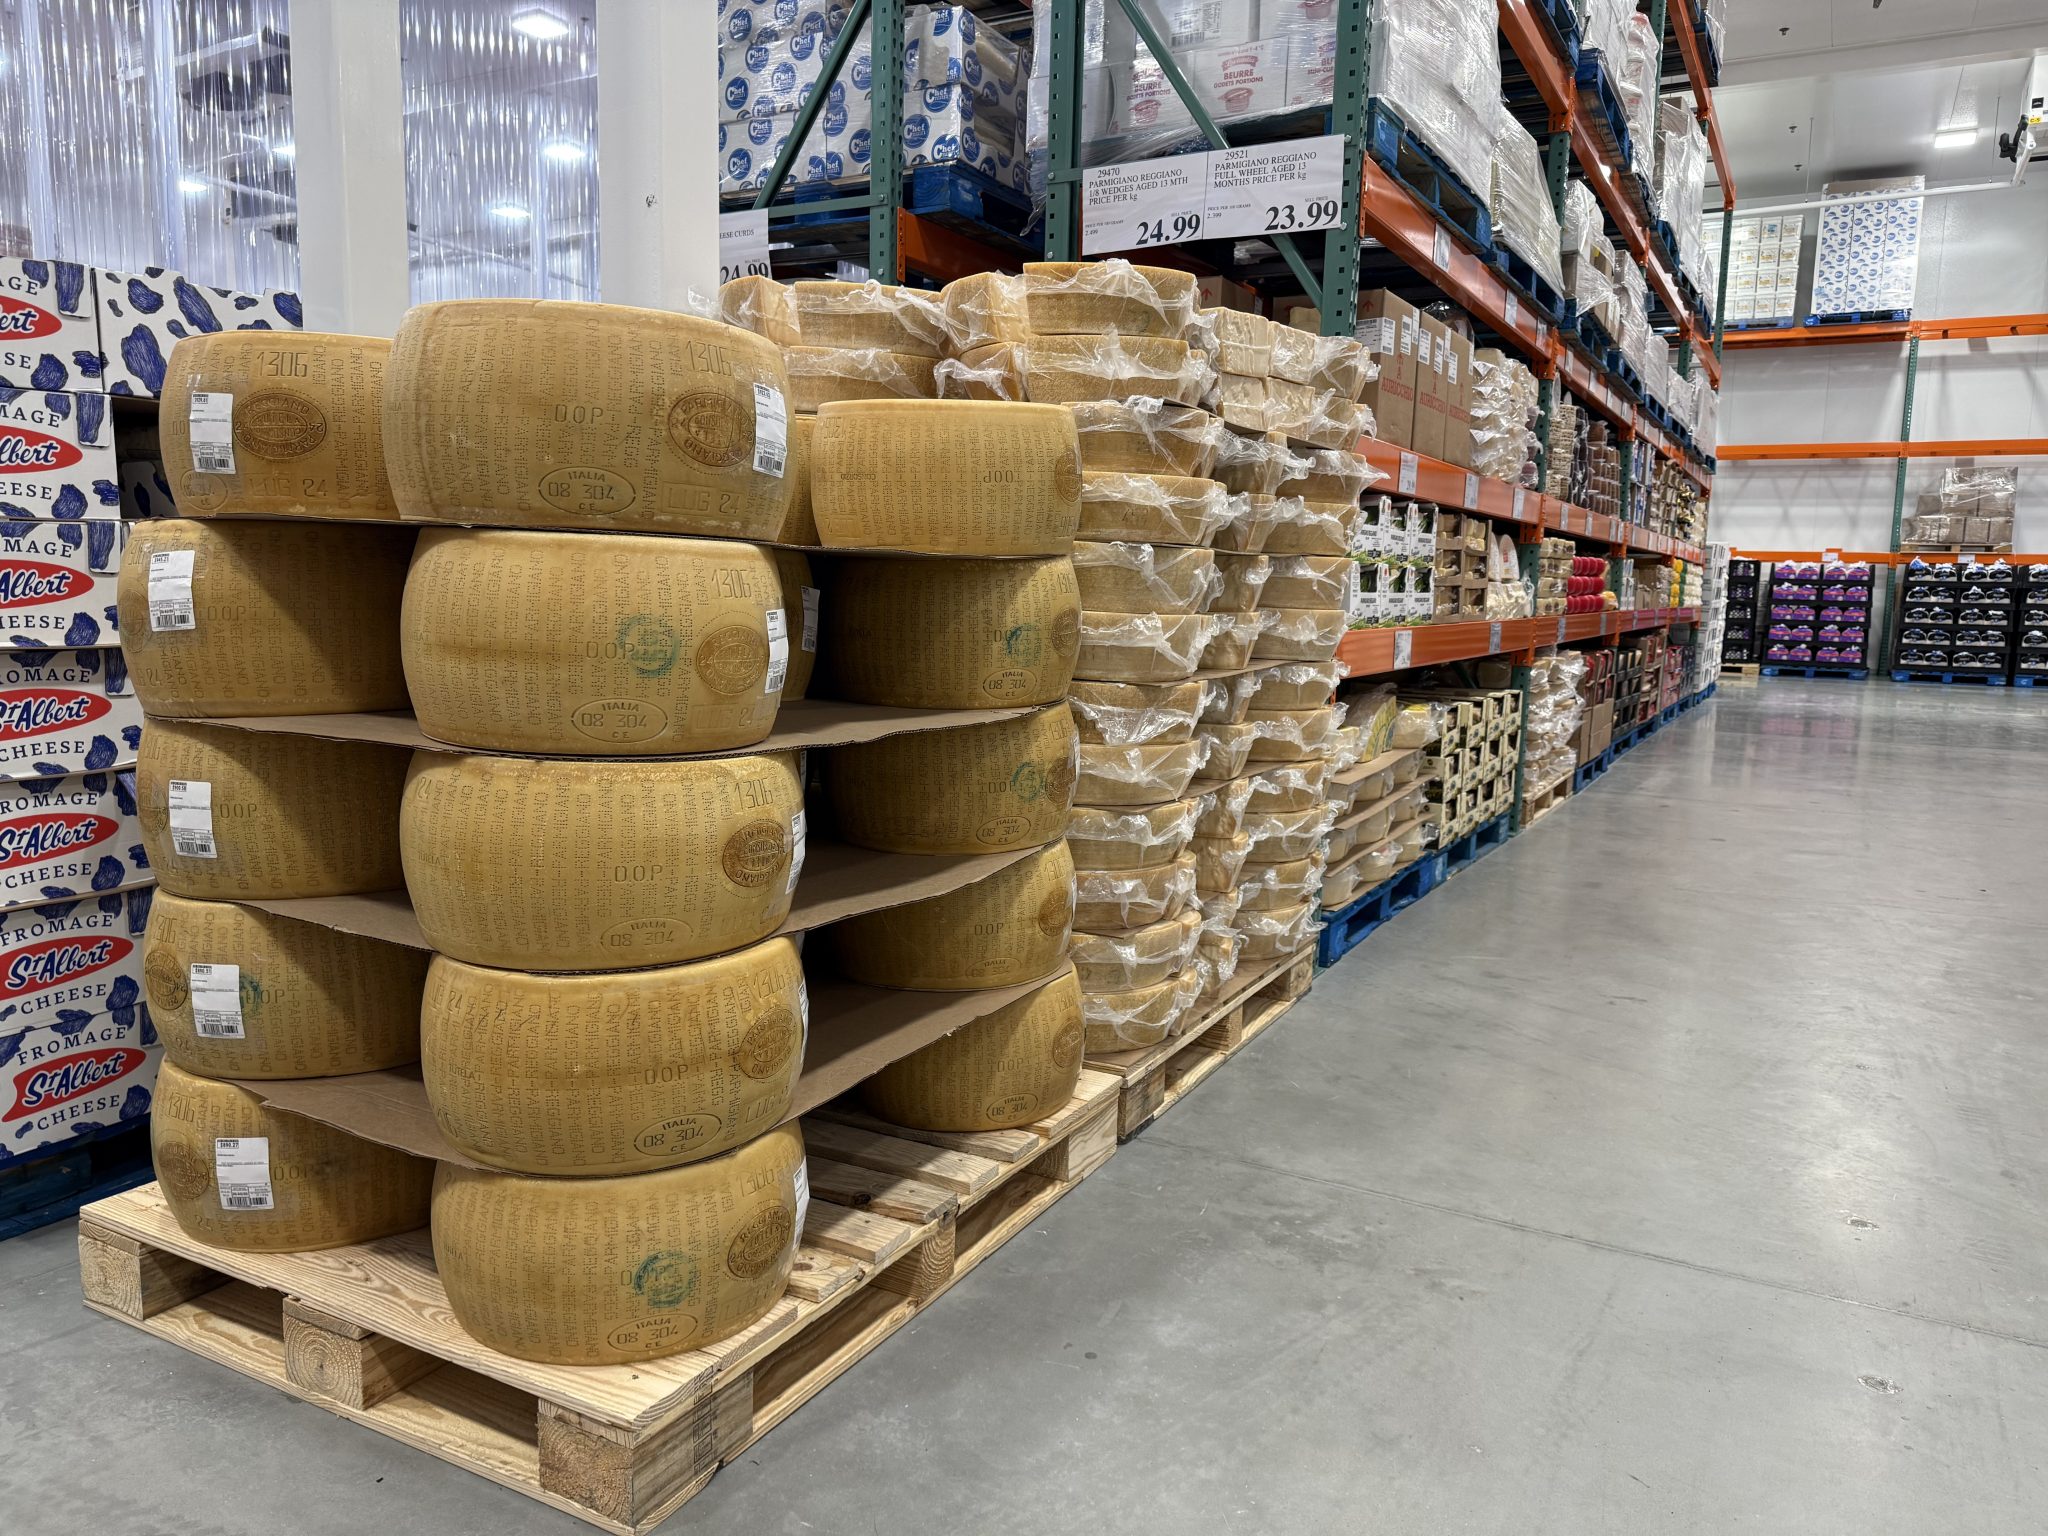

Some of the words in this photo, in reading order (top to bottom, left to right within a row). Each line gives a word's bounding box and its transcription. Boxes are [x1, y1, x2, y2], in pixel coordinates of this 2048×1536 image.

[730, 18, 748, 32] Chef
[791, 34, 811, 51] Chef
[747, 48, 765, 64] Chef
[1214, 81, 1234, 89] GODETS
[1235, 76, 1263, 86] PORTIONS
[1223, 69, 1254, 80] BEURRE
[726, 84, 744, 99] Chef
[926, 88, 948, 102] Chef
[750, 122, 768, 136] Chef
[904, 123, 924, 138] Chef
[934, 142, 956, 160] Chef
[1225, 150, 1248, 160] 29521
[730, 156, 748, 168] Chef
[1215, 158, 1268, 171] PARMIGIANO
[1271, 152, 1317, 164] REGGIANO
[1089, 175, 1138, 188] PARMIGIANO
[1140, 169, 1182, 181] REGGIANO
[1098, 168, 1120, 178] 29470
[1214, 171, 1236, 180] FULL
[1238, 167, 1268, 177] WHEEL
[1270, 164, 1295, 173] AGED
[1298, 162, 1307, 170] 13
[1214, 177, 1250, 188] MONTHS
[1252, 174, 1276, 185] PRICE
[1279, 173, 1295, 181] PER
[1297, 171, 1307, 180] kg
[1089, 189, 1100, 198] 1/8
[1100, 184, 1134, 196] WEDGES
[1136, 181, 1158, 192] AGED
[1160, 180, 1168, 188] 13
[1170, 177, 1188, 186] MTH
[1089, 196, 1111, 206] PRICE
[1130, 193, 1138, 202] kg
[1265, 200, 1338, 231] 23.99
[734, 229, 754, 238] CURDS
[1136, 214, 1200, 245] 24.99
[720, 262, 768, 285] 2499
[0, 276, 38, 296] GE
[257, 352, 308, 377] 1306
[686, 340, 732, 376] 1306
[568, 472, 606, 483] ITALIA
[302, 479, 327, 496] 24
[549, 482, 570, 498] 08
[583, 484, 614, 500] 304
[719, 493, 740, 514] 24
[4, 538, 72, 558] MAGE
[0, 570, 71, 602] Albert
[712, 569, 752, 598] 1306
[0, 668, 91, 684] OMAGE
[989, 679, 1002, 690] 08
[602, 702, 640, 712] ITALIA
[582, 712, 603, 728] 08
[616, 714, 647, 728] 304
[0, 741, 85, 762] CHEESE
[1, 792, 98, 814] ROMAGE
[735, 780, 774, 809] 1306
[6, 863, 92, 889] CHEESE
[1, 914, 113, 946] FROMAGE
[611, 934, 631, 946] 08
[754, 966, 786, 998] 1306
[21, 983, 106, 1015] CHEESE
[18, 1026, 126, 1066] FROMAGE
[37, 1095, 120, 1131] CHEESE
[662, 1118, 697, 1130] ITALIA
[643, 1134, 664, 1148] 08
[676, 1126, 703, 1142] 304
[636, 1313, 671, 1328] ITALIA
[617, 1331, 638, 1344] 08
[650, 1326, 679, 1339] 304
